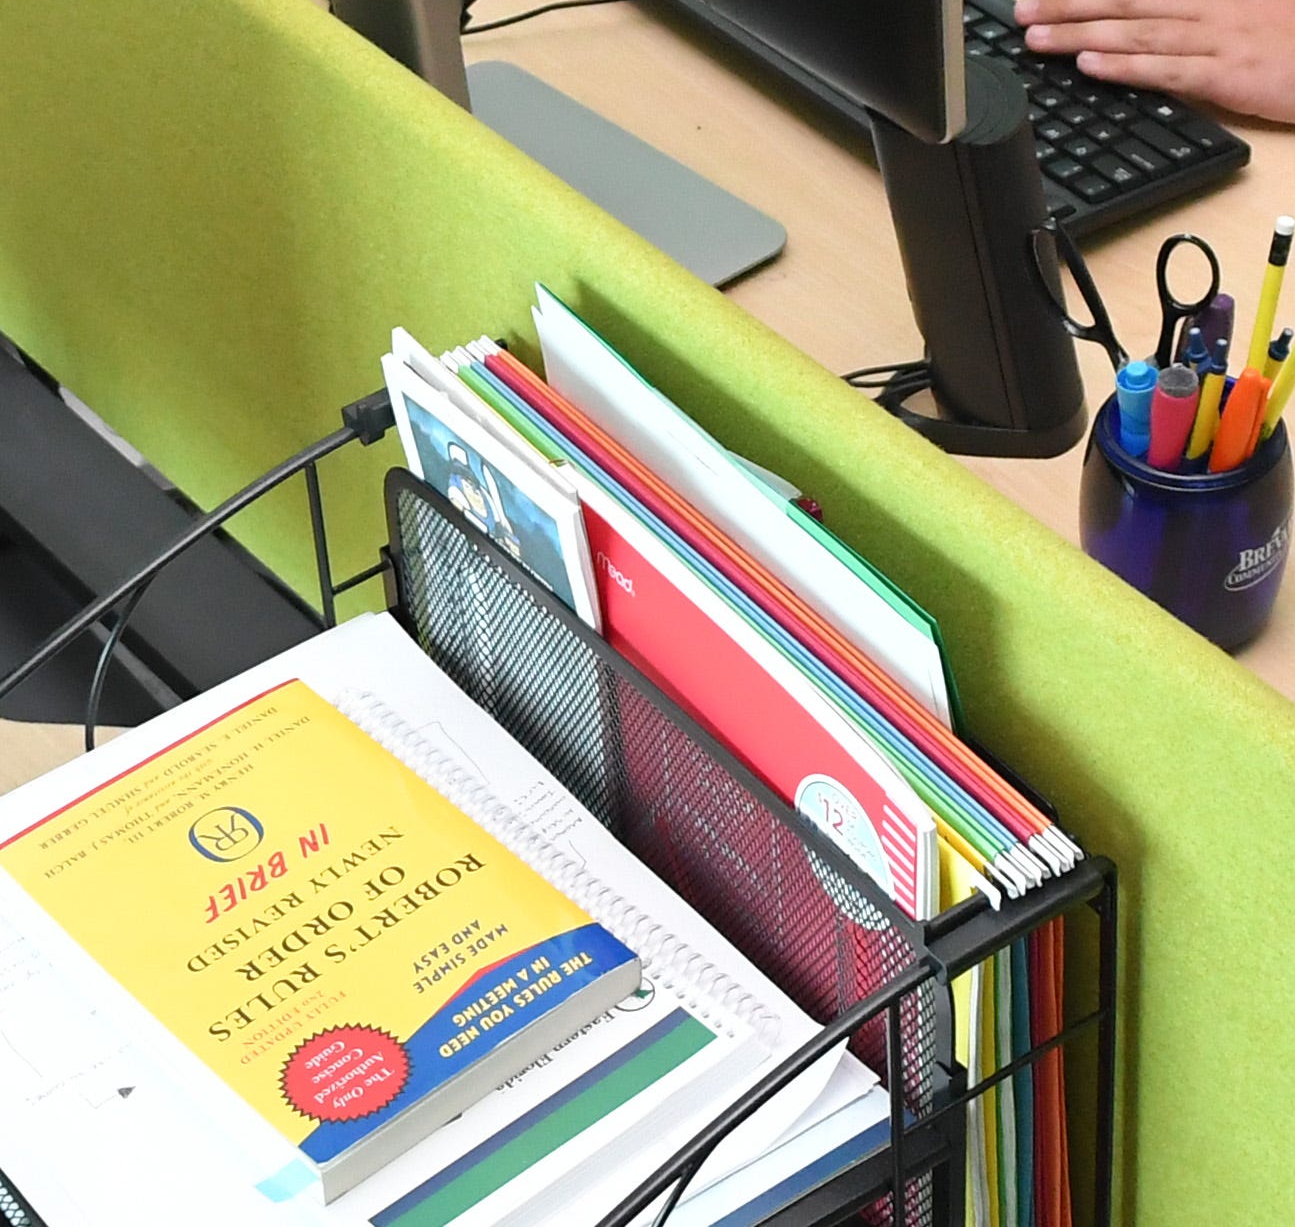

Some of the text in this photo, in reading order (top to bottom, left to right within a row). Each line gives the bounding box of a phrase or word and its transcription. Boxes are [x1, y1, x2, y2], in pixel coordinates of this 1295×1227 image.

[597, 551, 634, 594] mead
[186, 825, 405, 974] NEWLY REVISED
[203, 822, 331, 925] IN BRIEF
[208, 853, 487, 1043] ROBERT'S RULES
[234, 865, 406, 983] OF ORDER
[412, 919, 481, 974] AND EASY
[415, 923, 508, 994] MADE SIMPLE
[242, 1006, 301, 1047] EDITION
[438, 951, 593, 1059] THE RULES YOU NEED
[452, 955, 551, 1028] IN A MEETING
[240, 990, 348, 1065] FULLY UPDATED
[304, 1040, 346, 1070] Guide
[311, 1047, 365, 1085] Concise
[312, 1051, 386, 1105] Authorized
[331, 1066, 395, 1109] The Only
